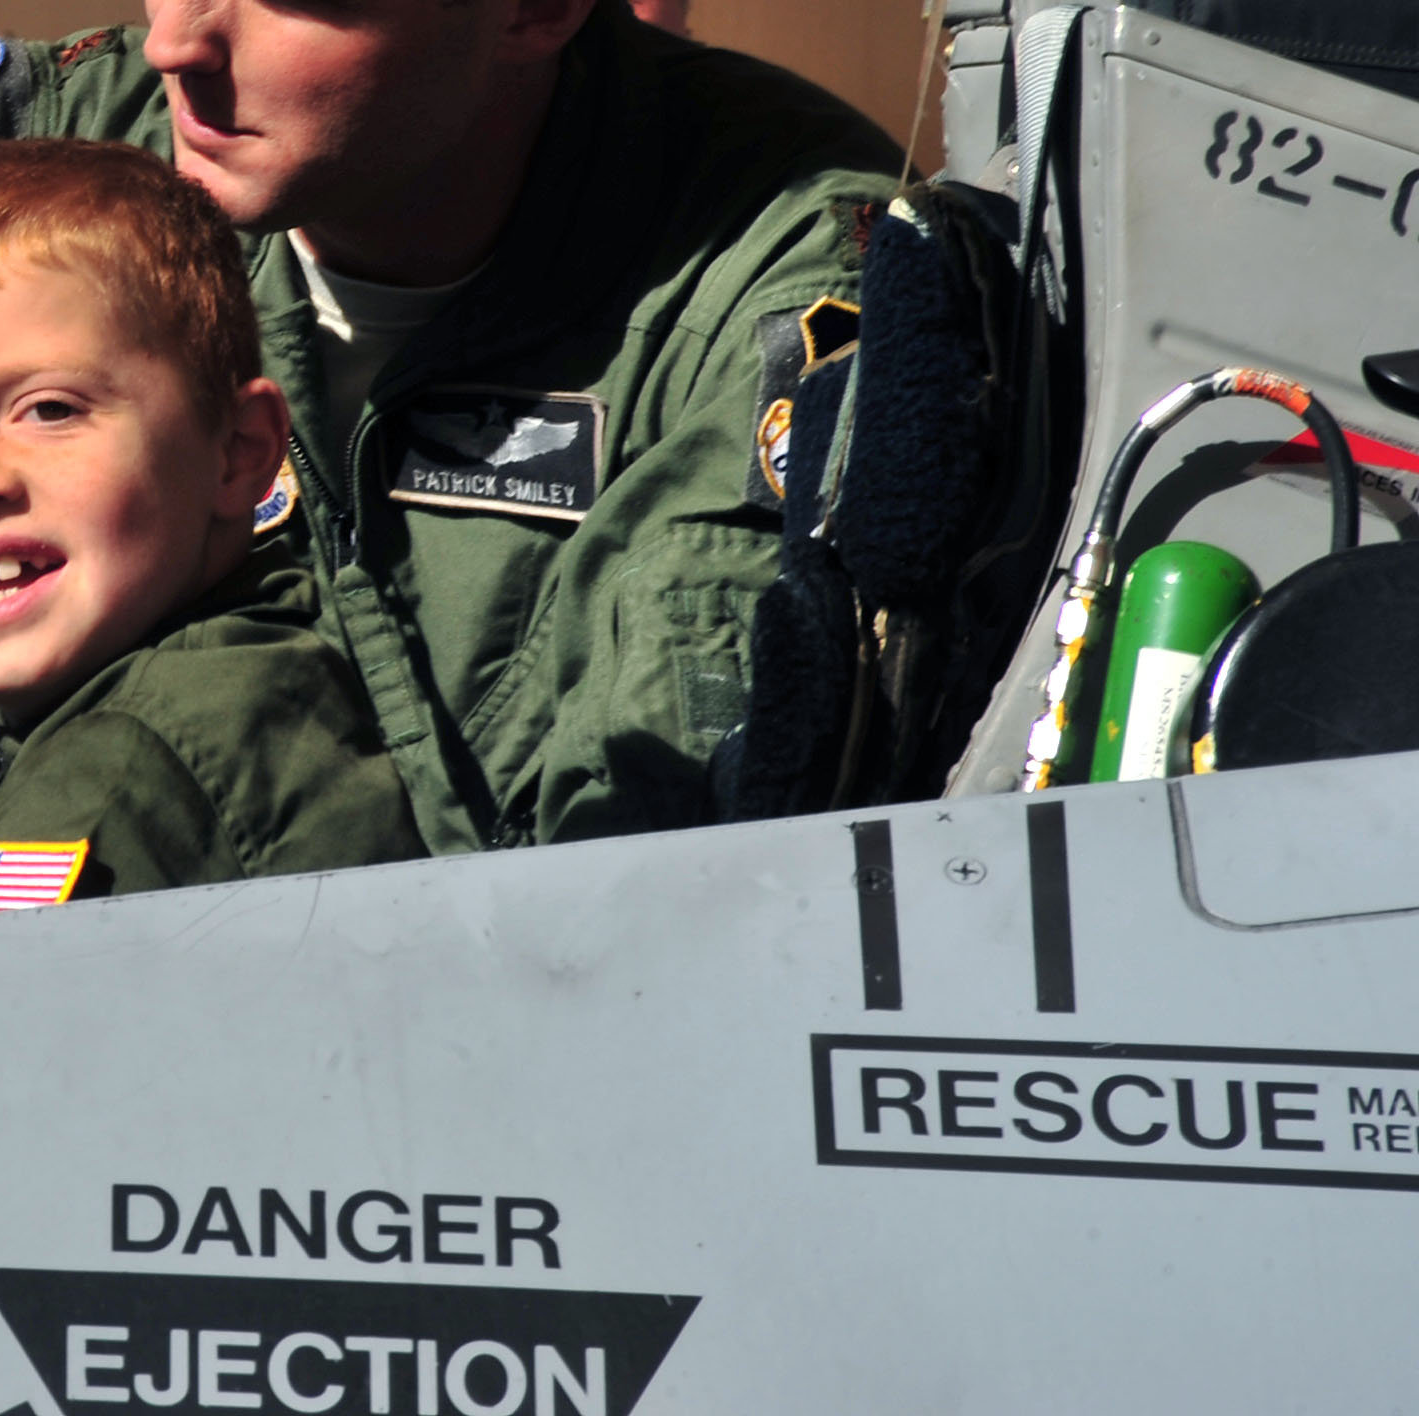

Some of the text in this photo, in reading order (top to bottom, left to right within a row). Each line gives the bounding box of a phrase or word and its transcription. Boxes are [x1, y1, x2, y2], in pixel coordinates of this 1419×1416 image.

[413, 468, 576, 507] PATRICK SMILEY
[860, 1067, 1325, 1152] RESCUE
[1347, 1086, 1419, 1117] MA
[1352, 1122, 1419, 1154] RE
[110, 1183, 561, 1269] DANGER
[65, 1324, 606, 1416] EJECTION
